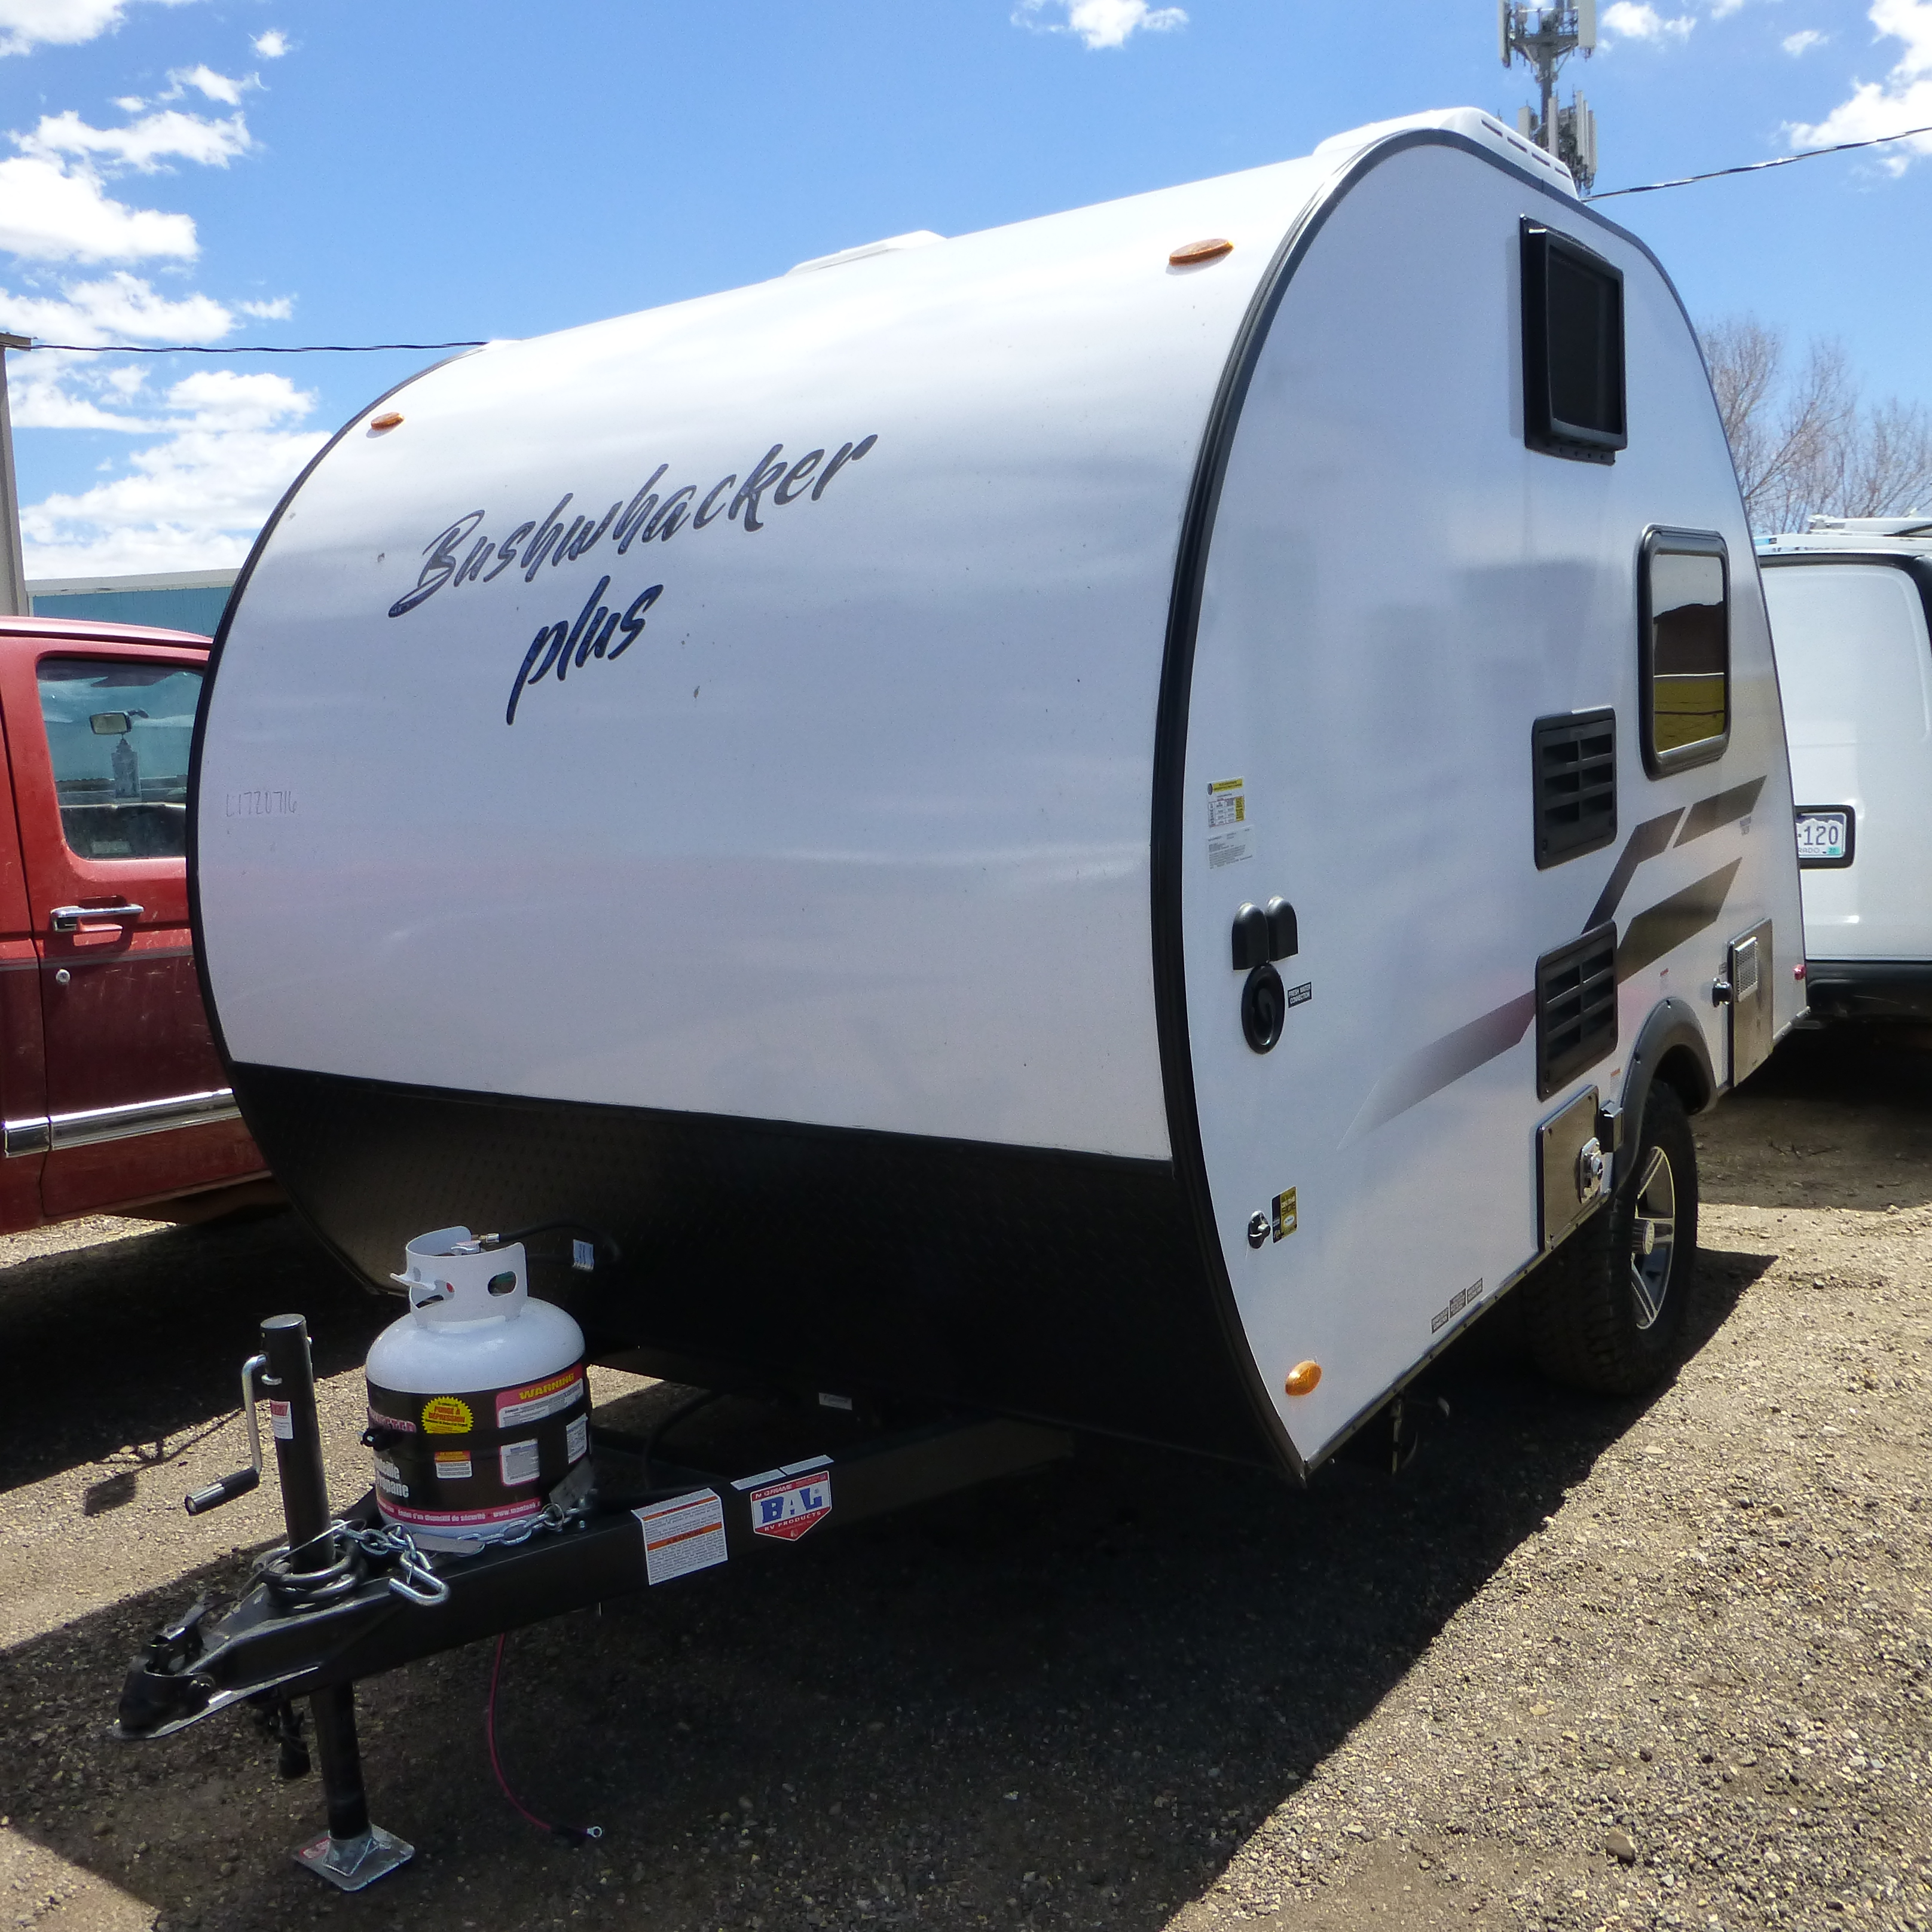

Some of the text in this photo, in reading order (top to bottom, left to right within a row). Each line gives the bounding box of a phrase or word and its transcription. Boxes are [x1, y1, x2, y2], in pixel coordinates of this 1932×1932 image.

[388, 434, 878, 618] Bushwhacker
[506, 576, 664, 725] plus
[519, 1373, 574, 1400] WARNING
[760, 1487, 823, 1524] BAL
[778, 1511, 822, 1527] PRODUCTS
